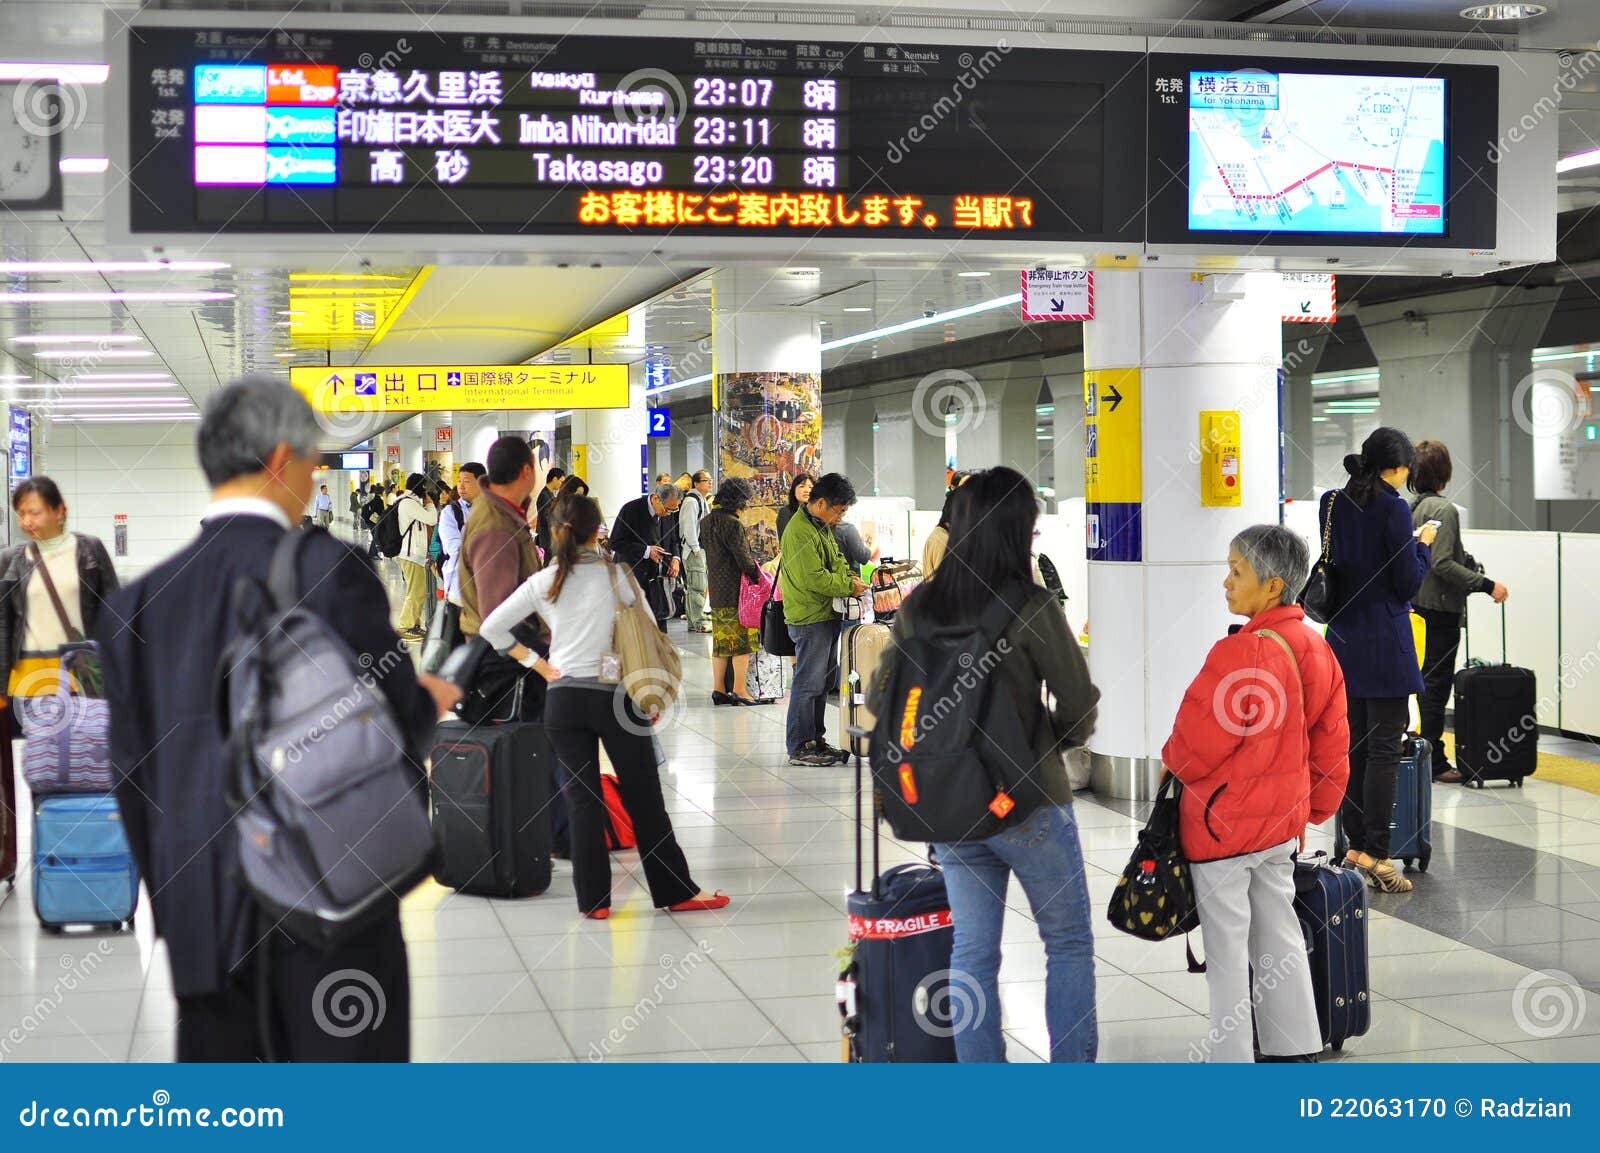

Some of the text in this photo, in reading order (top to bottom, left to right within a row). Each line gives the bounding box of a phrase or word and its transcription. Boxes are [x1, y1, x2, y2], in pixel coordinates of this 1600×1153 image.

[745, 47, 787, 57] Dep. Time
[826, 49, 844, 58] Cars
[904, 51, 940, 61] Remarks
[151, 68, 185, 85] 先発
[158, 86, 178, 97] 1st.
[337, 69, 502, 105] 京急久里浜
[692, 78, 773, 107] 23:07
[1154, 77, 1184, 94] 先発
[1160, 94, 1180, 105] 1st.
[1203, 95, 1265, 106] for Yokohama
[151, 108, 185, 125] 次発
[518, 113, 570, 145] Imba
[692, 116, 770, 146] 23:11
[532, 152, 663, 187] Takasago
[692, 155, 773, 185] 23:20
[385, 372, 437, 393] 出口
[464, 371, 597, 386] 国際線ターミナル
[464, 386, 574, 396] International Terminal
[385, 394, 411, 406] Exit
[653, 413, 667, 432] 2
[875, 914, 940, 934] FRAGILE
